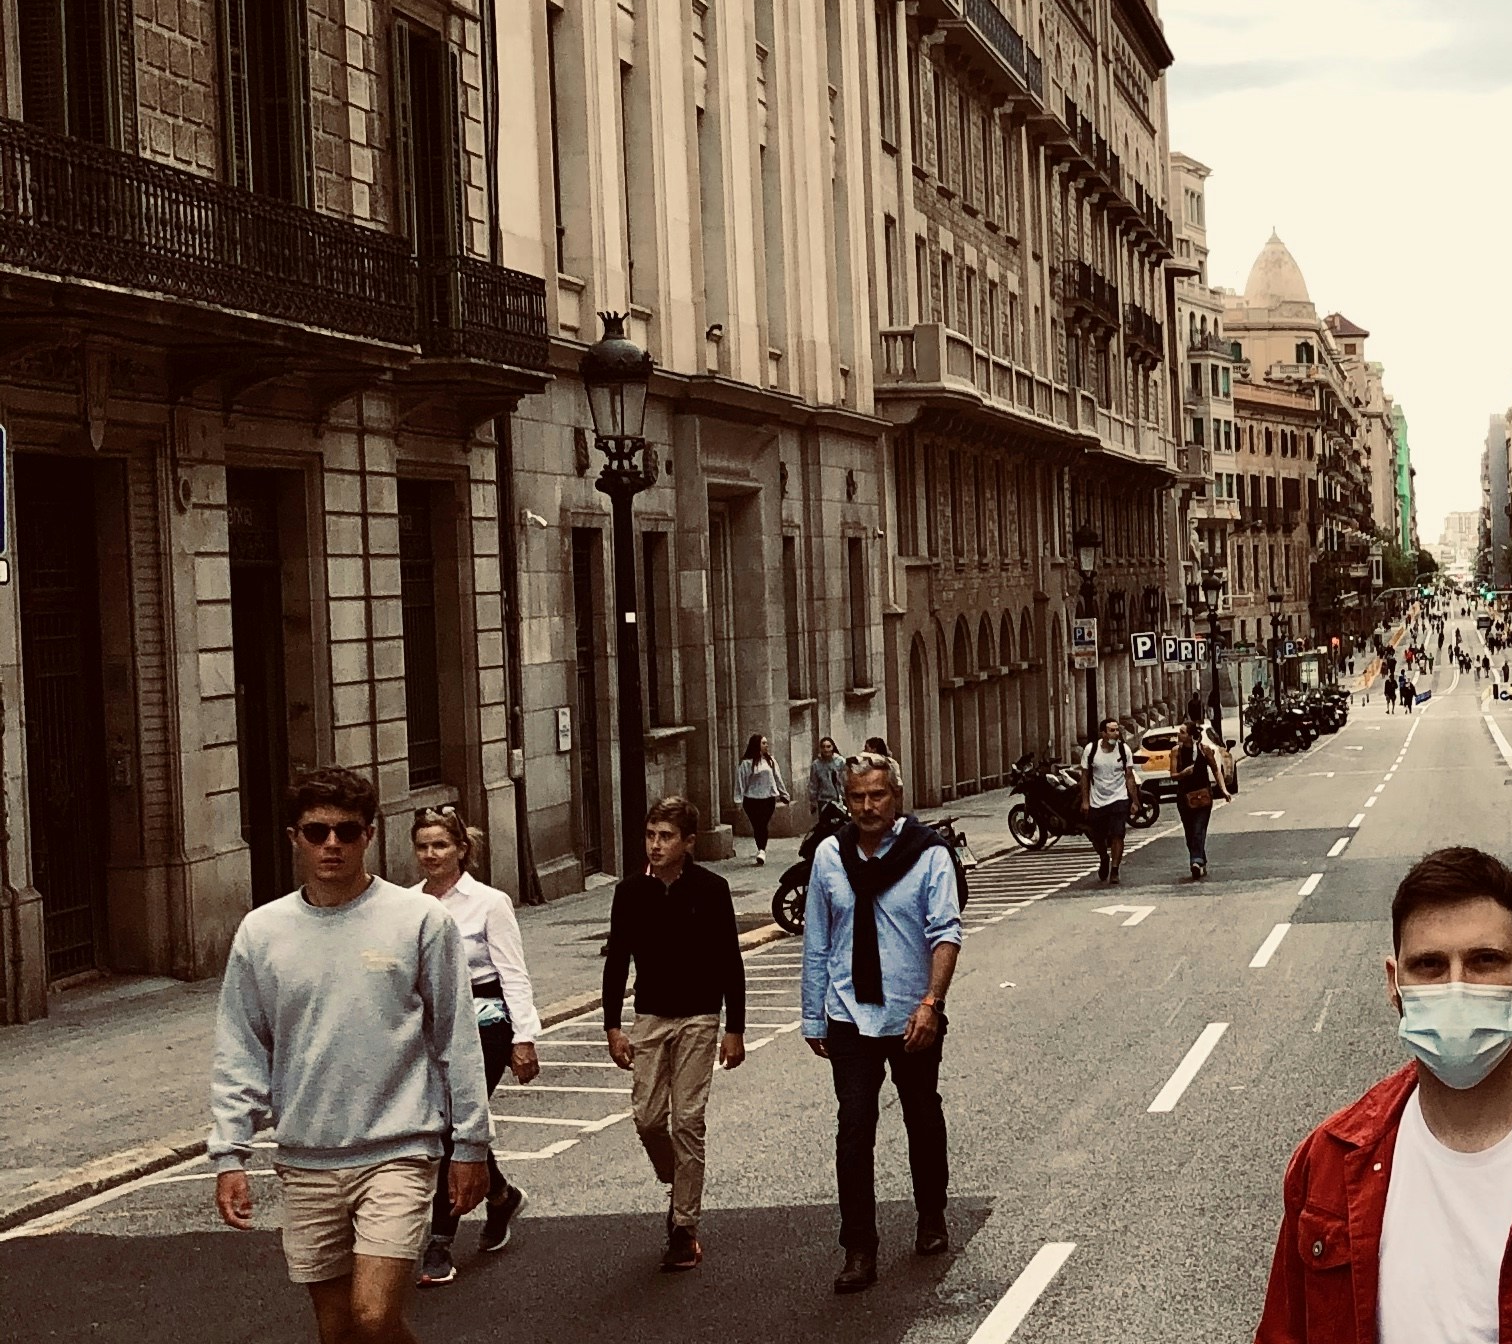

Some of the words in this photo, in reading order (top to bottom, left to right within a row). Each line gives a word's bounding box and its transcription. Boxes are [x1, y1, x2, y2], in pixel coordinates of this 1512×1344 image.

[1136, 636, 1152, 658] P
[1165, 639, 1175, 659] P
[1285, 642, 1294, 655] P
